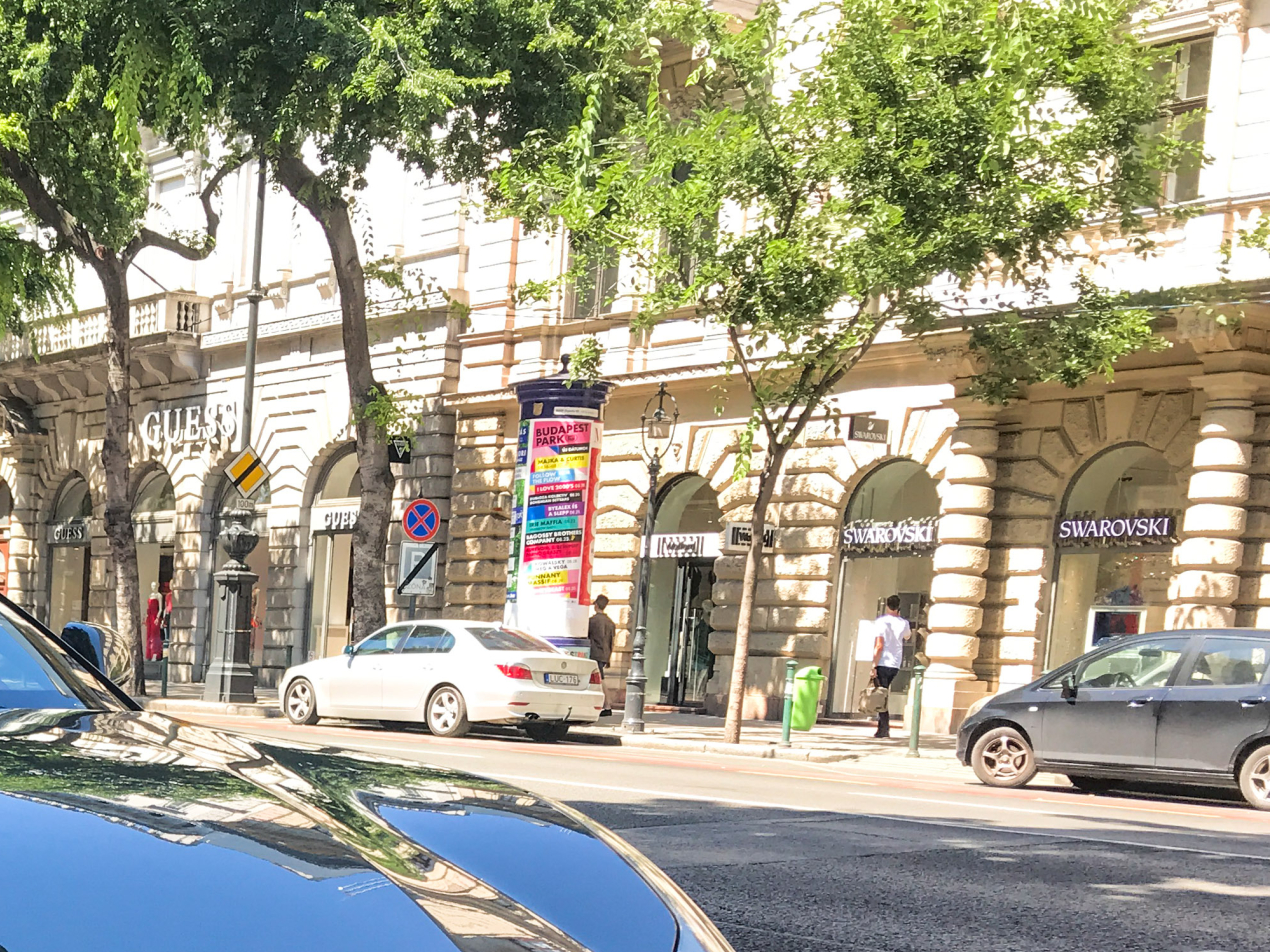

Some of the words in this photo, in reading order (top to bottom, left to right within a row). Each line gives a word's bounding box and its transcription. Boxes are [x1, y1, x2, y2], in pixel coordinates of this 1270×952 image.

[141, 404, 237, 446] GUESS
[536, 424, 589, 437] BUDAPEST
[536, 435, 565, 447] PARK
[854, 431, 887, 441] SWAROVSKI
[325, 511, 359, 528] GUES
[54, 526, 82, 540] GUESS
[843, 526, 934, 544] SWAROVSKI
[1059, 517, 1170, 538] SWAROVSKI
